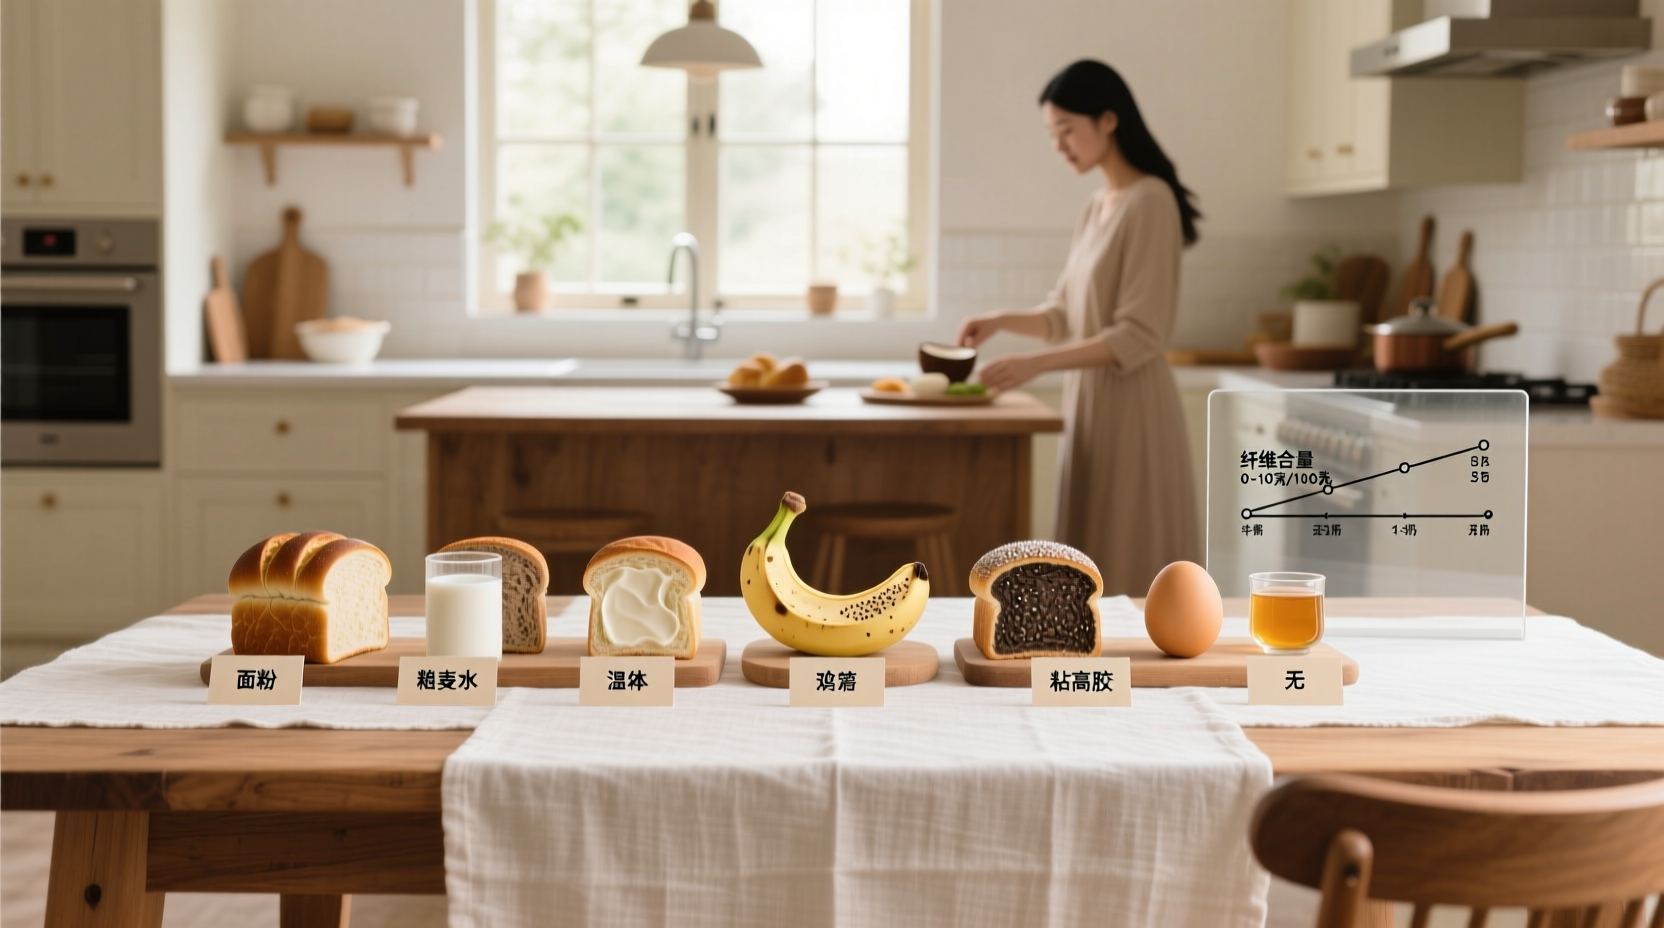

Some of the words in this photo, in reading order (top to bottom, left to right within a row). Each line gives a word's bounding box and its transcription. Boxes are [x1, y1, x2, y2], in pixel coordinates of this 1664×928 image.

[237, 669, 277, 690] 面粉
[1050, 670, 1114, 692] 粘高胶
[1285, 671, 1305, 690] 无
